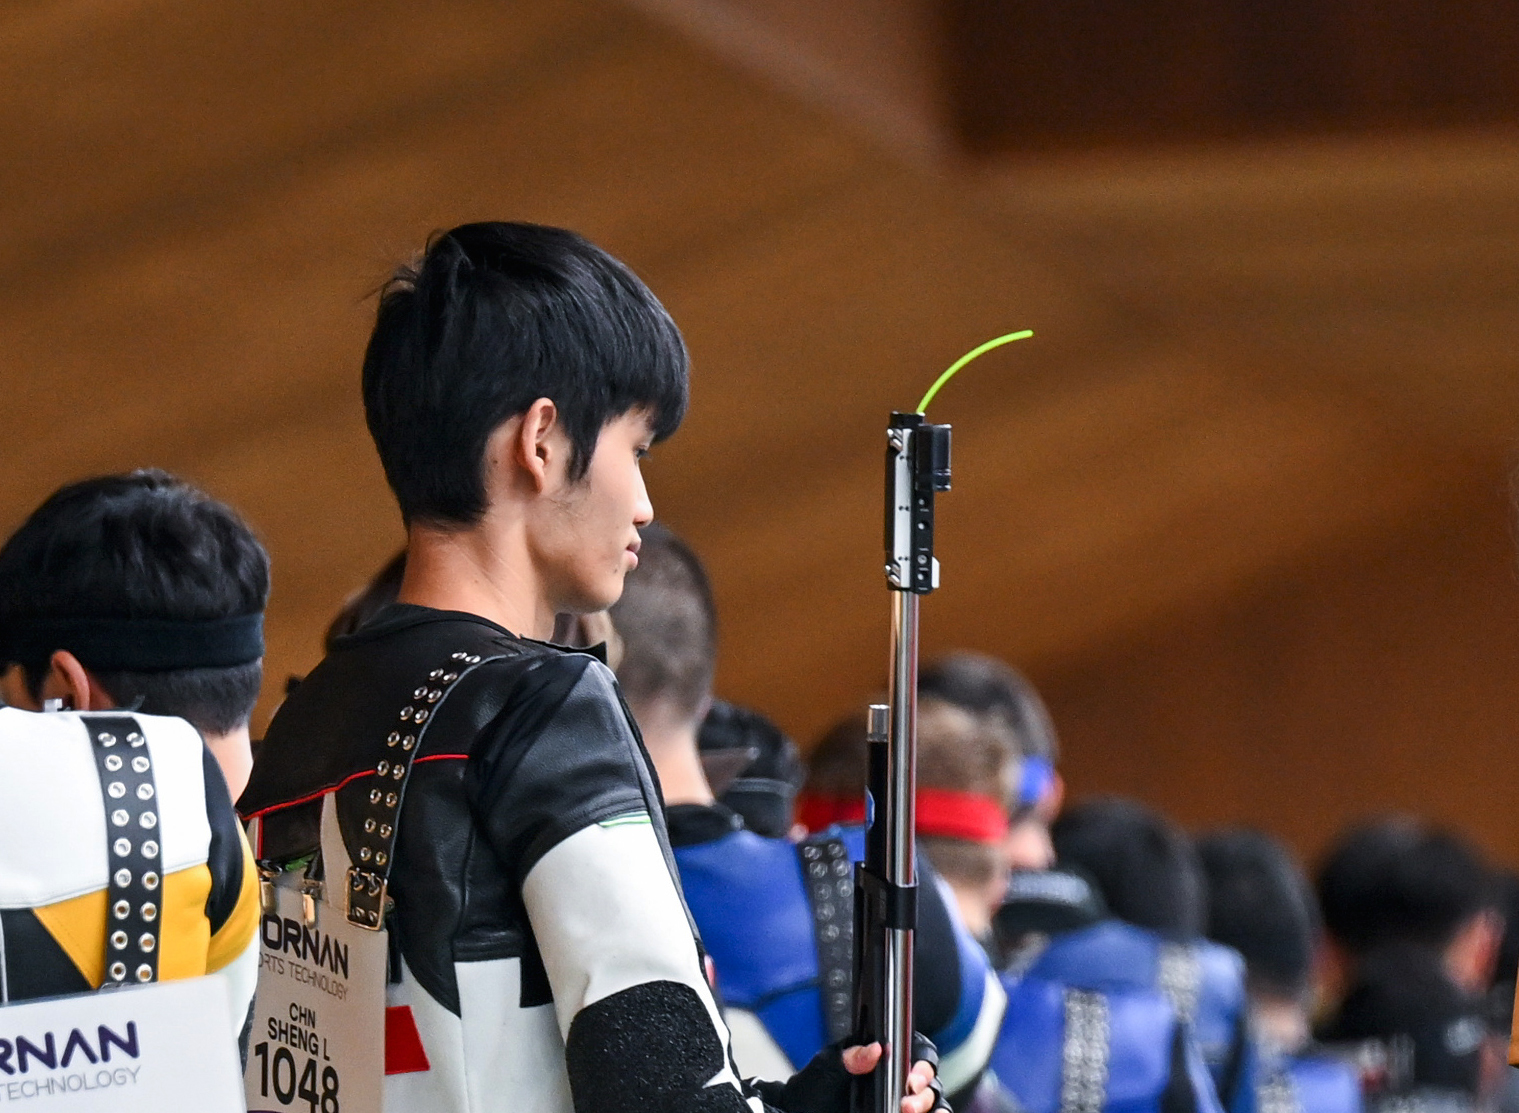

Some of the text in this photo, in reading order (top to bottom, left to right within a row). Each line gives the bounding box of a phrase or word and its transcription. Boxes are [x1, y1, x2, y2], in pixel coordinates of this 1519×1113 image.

[262, 914, 348, 980] ORNAN
[288, 961, 348, 1000] TECHNOLOGY
[289, 1002, 316, 1029] CHN
[267, 1017, 330, 1061] SHENG L
